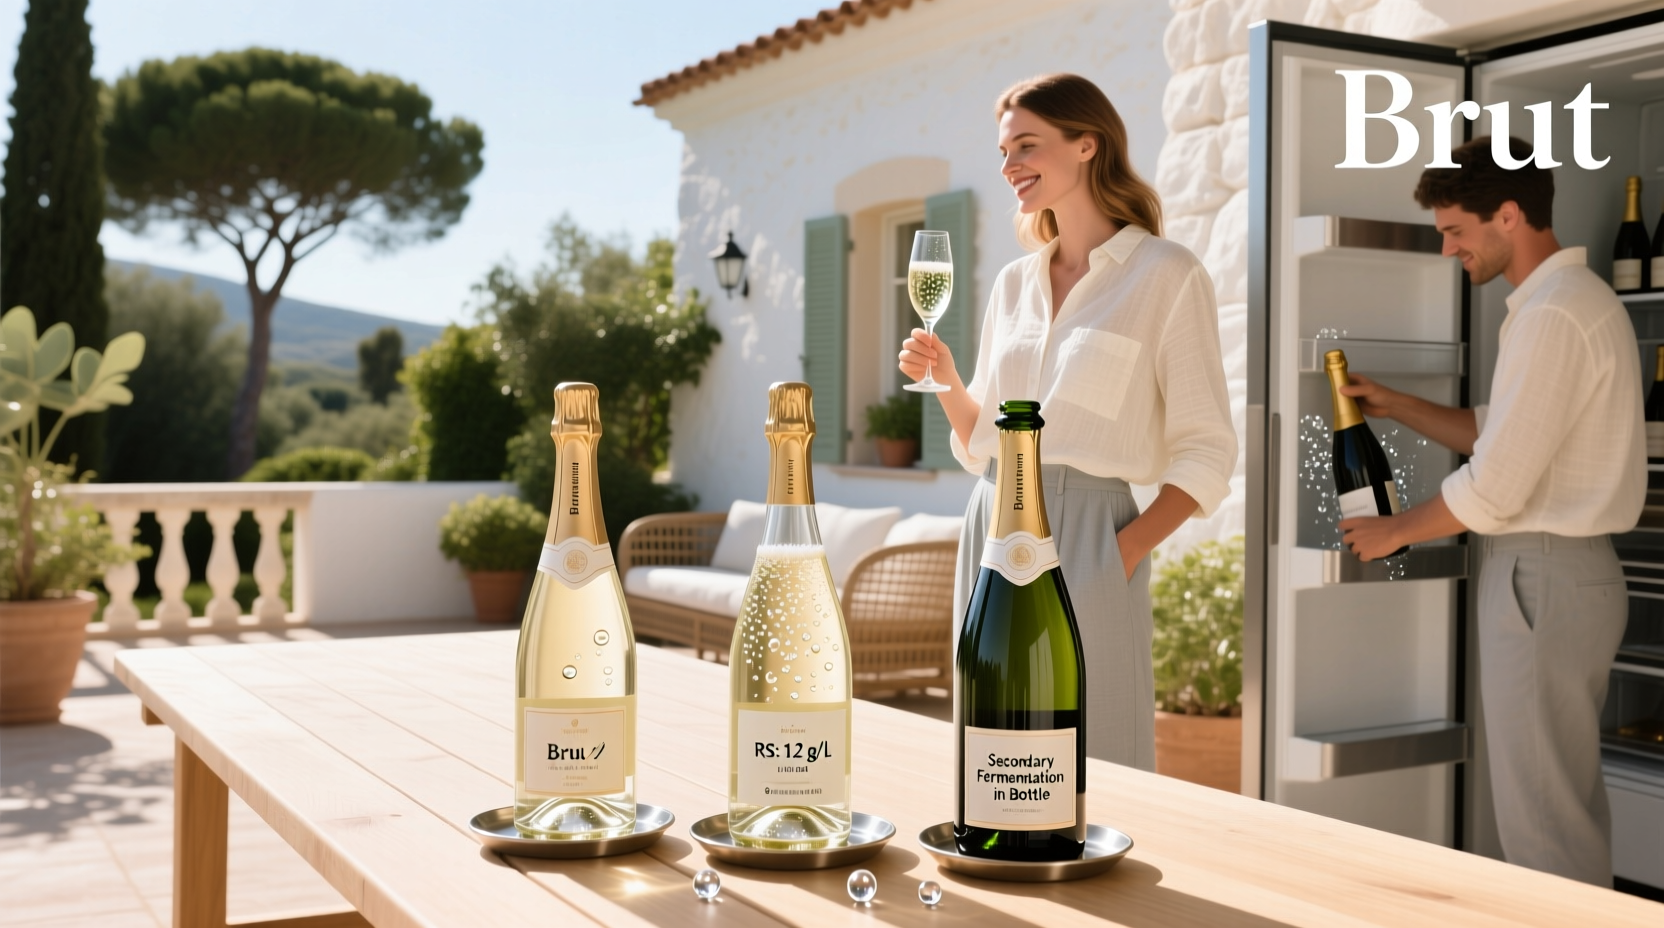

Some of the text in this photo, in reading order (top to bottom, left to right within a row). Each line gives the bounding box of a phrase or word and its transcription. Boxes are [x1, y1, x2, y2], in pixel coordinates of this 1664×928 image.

[755, 740, 832, 762] RS: 12 g/L
[988, 753, 1054, 769] Secondary
[994, 787, 1050, 801] in Bottle
